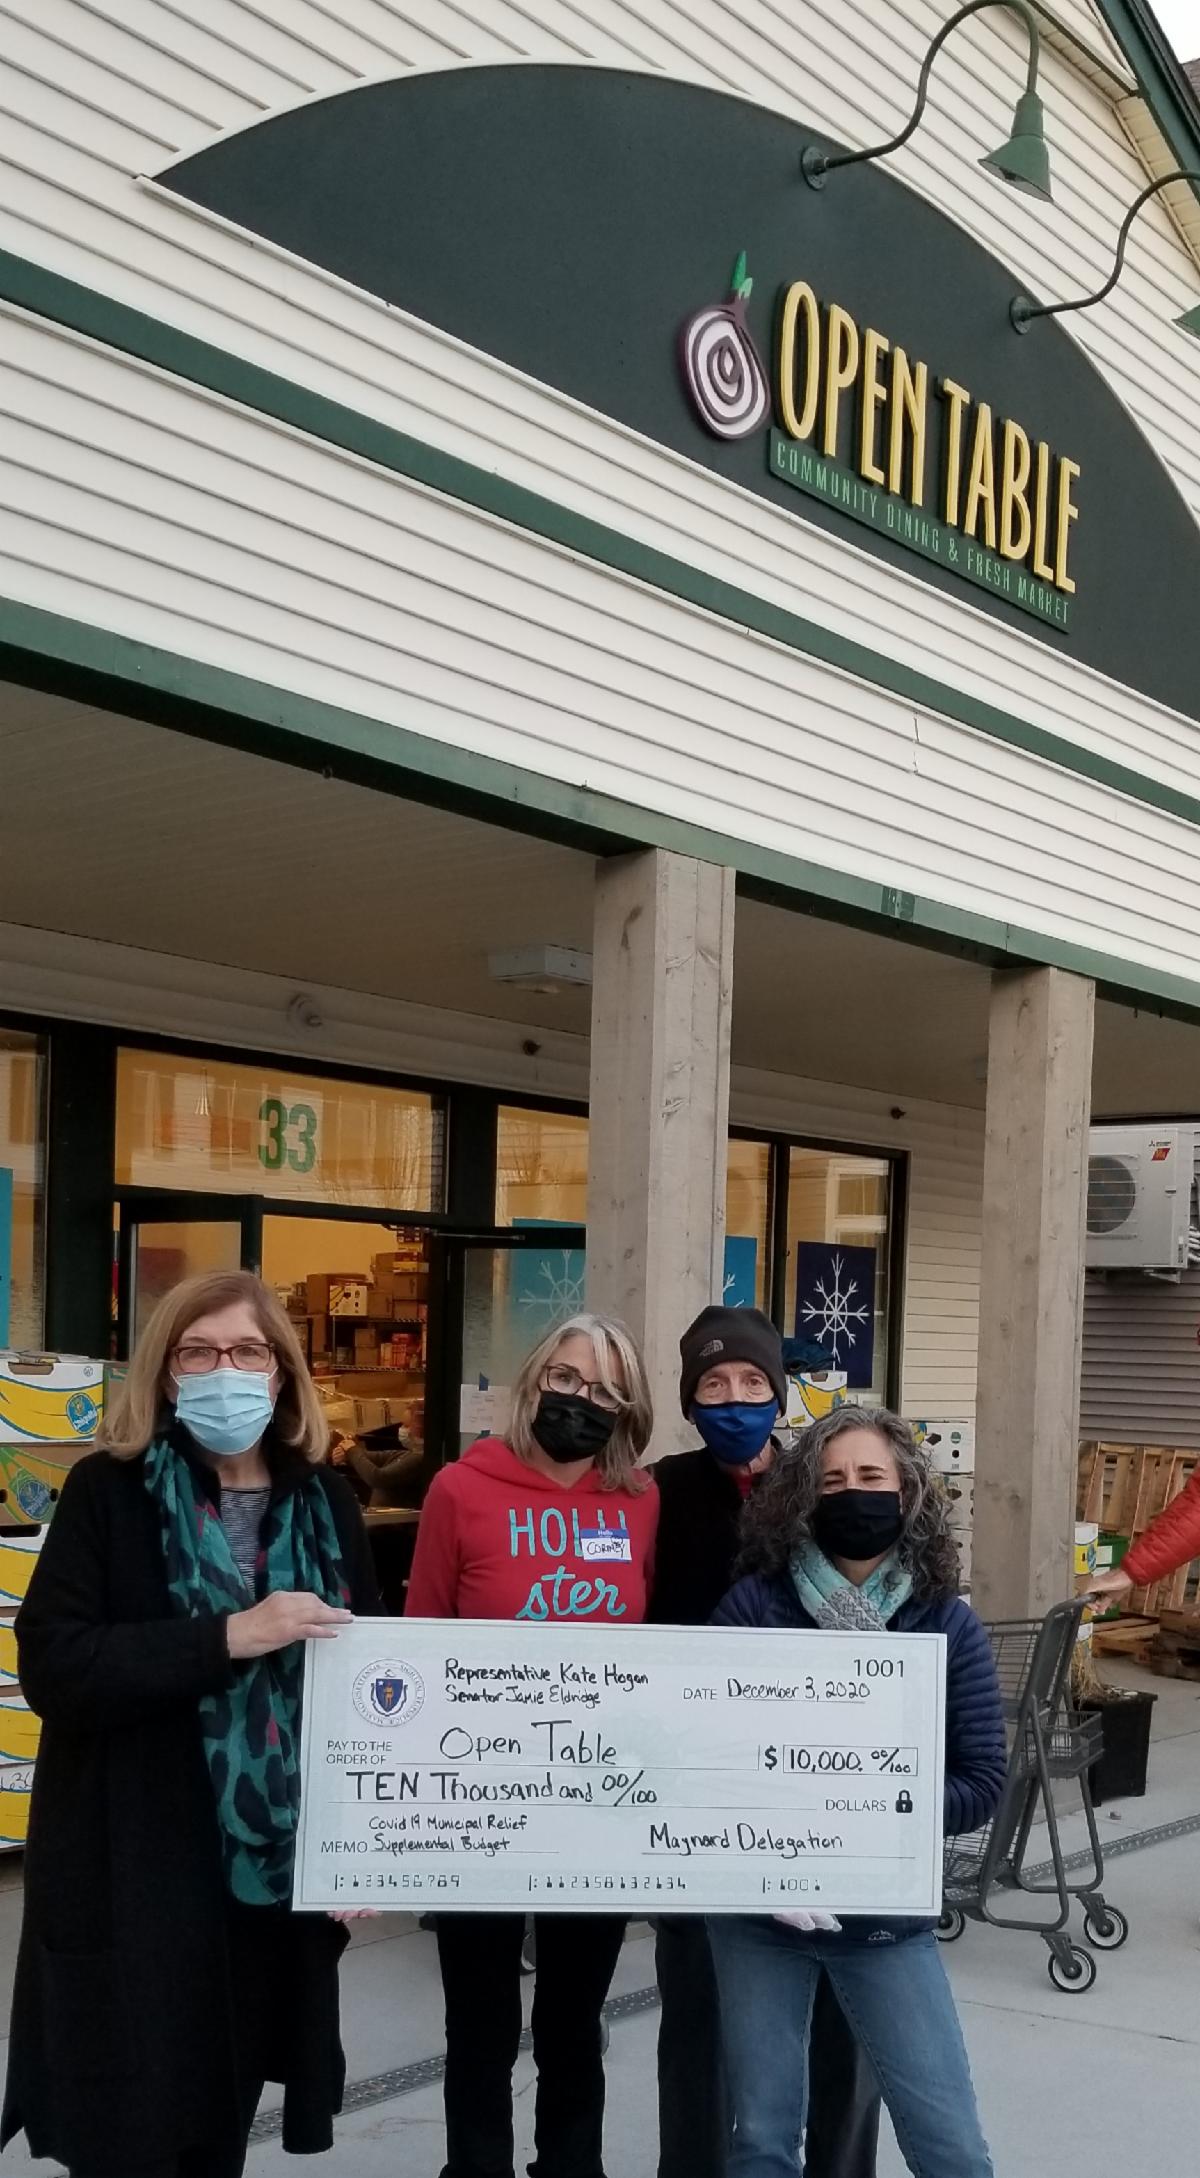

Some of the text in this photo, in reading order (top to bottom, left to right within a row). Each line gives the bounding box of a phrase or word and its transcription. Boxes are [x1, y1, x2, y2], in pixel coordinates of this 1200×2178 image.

[780, 281, 1081, 594] OPEN TABLE
[777, 441, 1069, 624] COMMUNITY DINING & FRESH MARKET
[257, 1098, 318, 1174] 33
[515, 1565, 627, 1620] ster
[445, 1657, 649, 1692] Representative Kate Hogan
[853, 1659, 905, 1678] 1001
[445, 1684, 601, 1709] Senator Jamie Eldridge
[683, 1676, 871, 1702] DATE December 3, 2020
[327, 1740, 392, 1752] PAY TO THE
[439, 1719, 617, 1765] Open Table
[326, 1754, 386, 1765] ORDER OF
[764, 1744, 778, 1771] $
[346, 1771, 420, 1801] TEN
[430, 1771, 554, 1802] Thousand
[558, 1782, 594, 1803] and
[825, 1799, 887, 1812] DOLLARS
[368, 1814, 528, 1834] Covid 19 Municipal Relief
[321, 1832, 511, 1857] MEMO Supplemental Budget
[650, 1822, 843, 1859] Maynard Delegation
